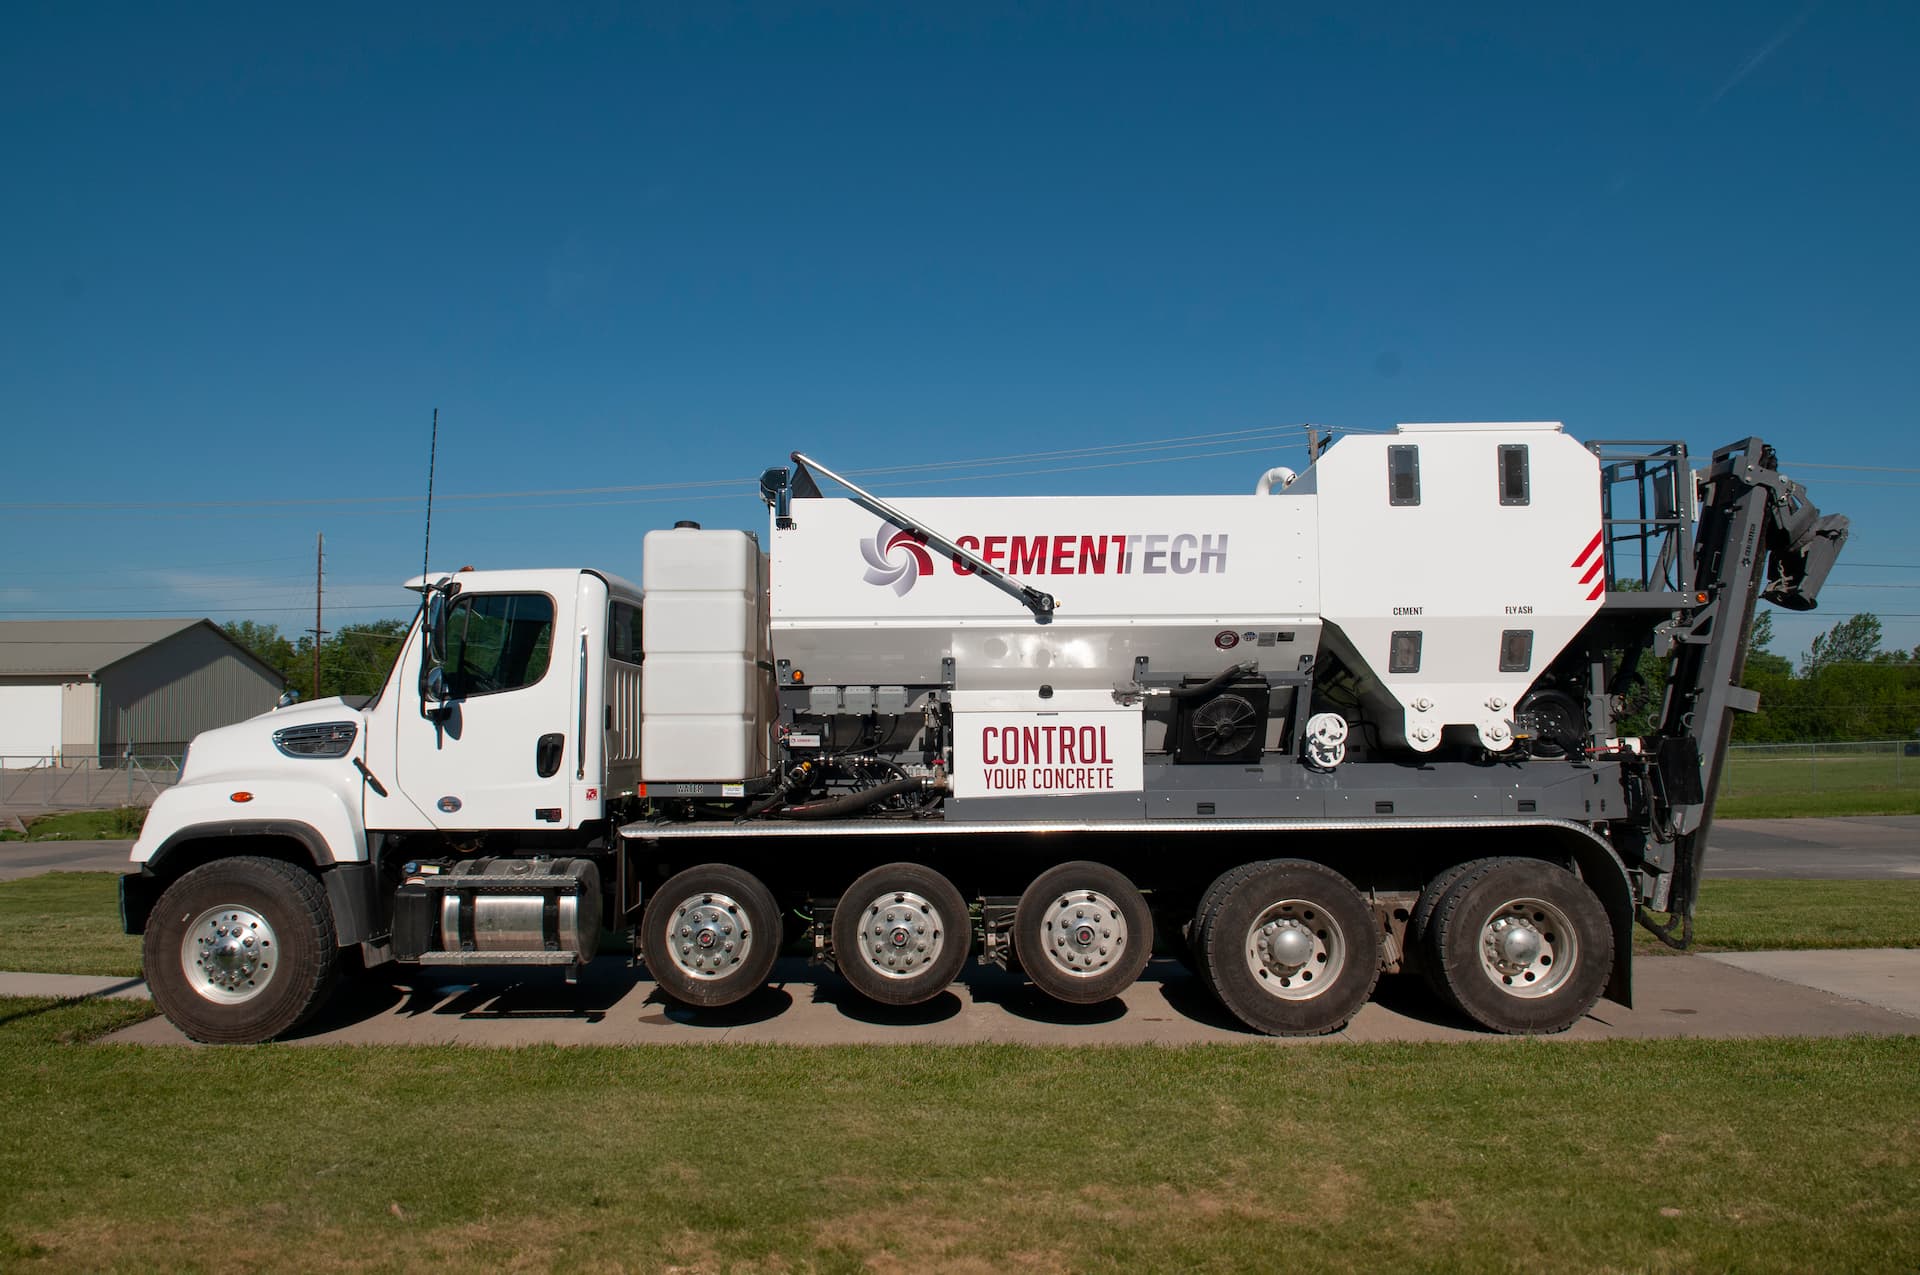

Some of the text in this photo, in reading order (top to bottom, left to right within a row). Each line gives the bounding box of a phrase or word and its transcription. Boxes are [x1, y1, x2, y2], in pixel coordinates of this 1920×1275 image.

[1393, 607, 1423, 615] CEMENT
[1505, 606, 1533, 614] FLY ASH
[982, 726, 1114, 765] CONTROL
[984, 768, 1114, 789] YOUR CONCRETE
